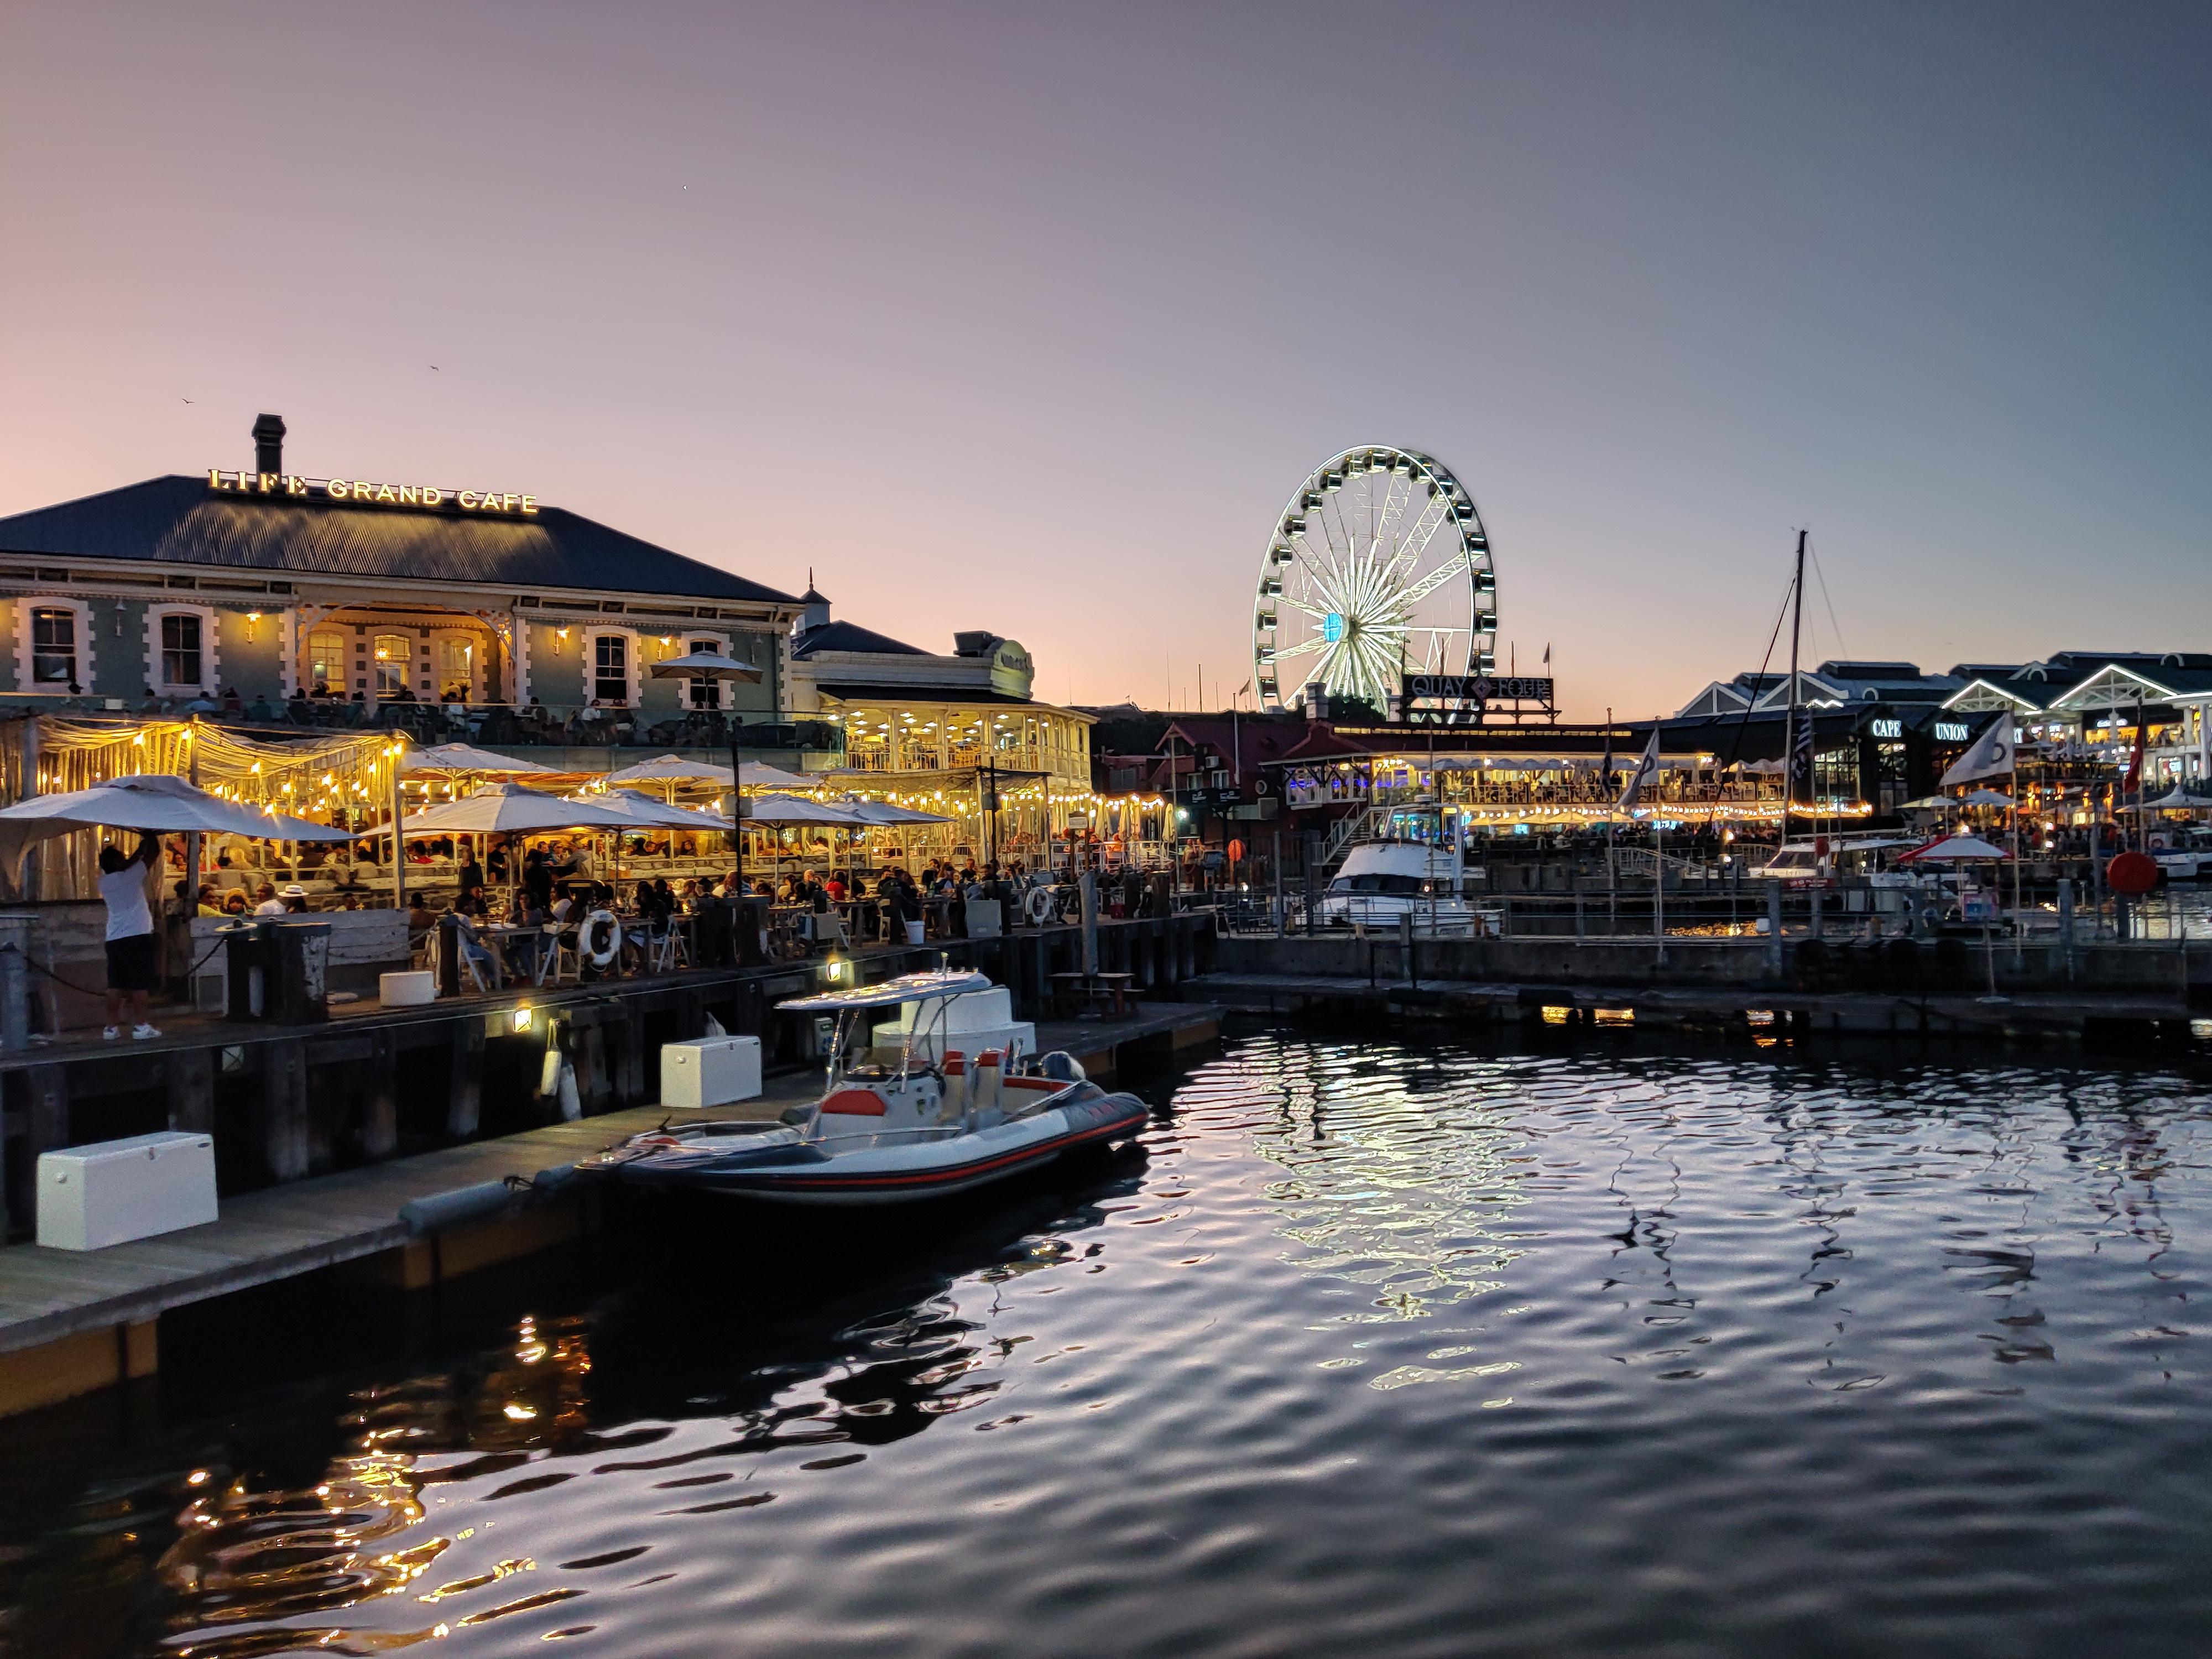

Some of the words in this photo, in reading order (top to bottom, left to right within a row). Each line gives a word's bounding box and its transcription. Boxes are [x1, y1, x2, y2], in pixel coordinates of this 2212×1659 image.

[208, 468, 307, 496] LIFE
[327, 478, 442, 506] GRAND
[458, 489, 539, 514] CAFE
[1412, 676, 1466, 696] QUAY
[1498, 678, 1547, 700] FOUR
[1872, 719, 1902, 738] CAPE
[1935, 723, 1969, 741] UNION
